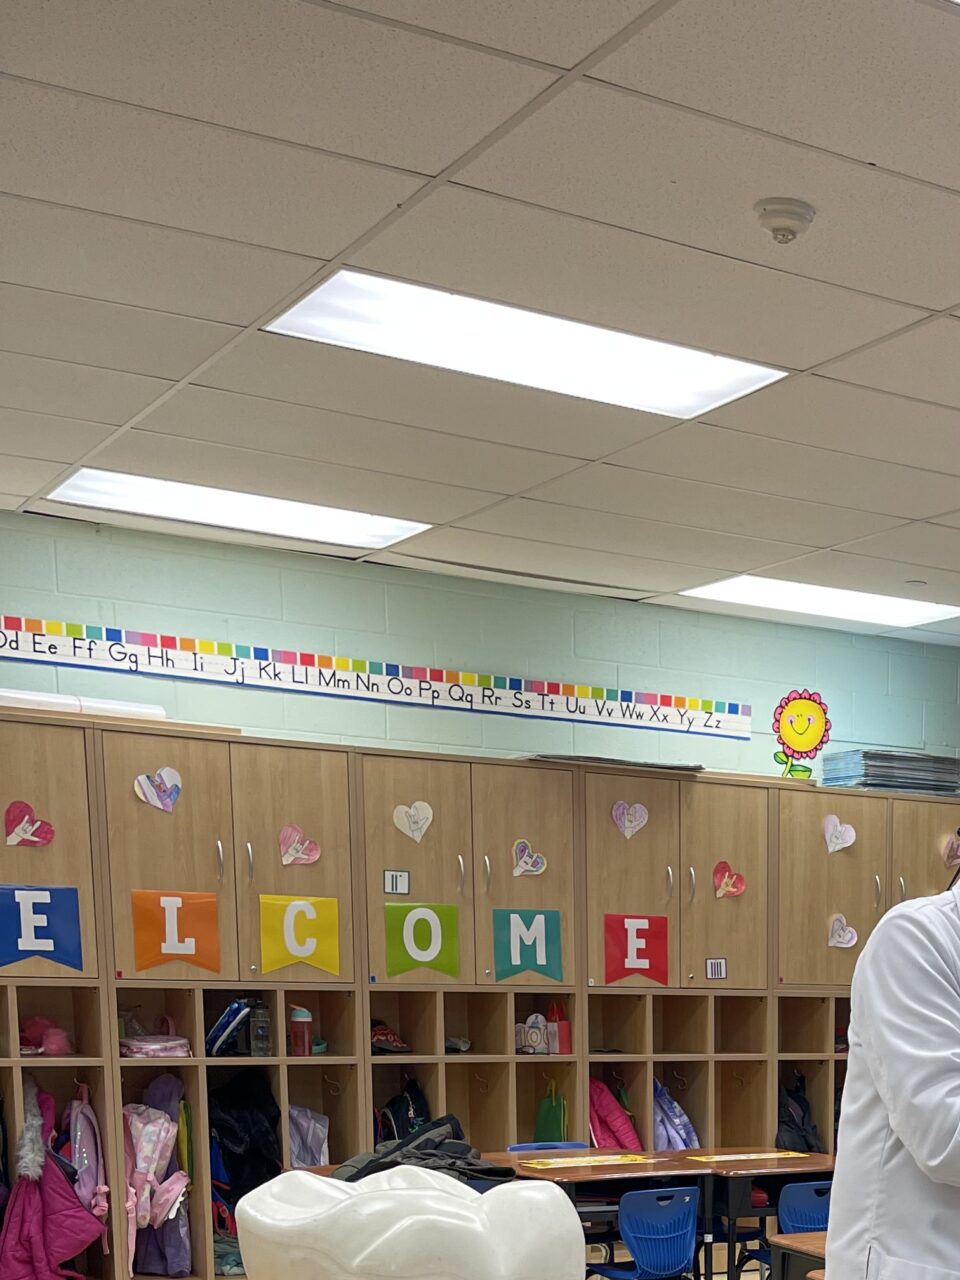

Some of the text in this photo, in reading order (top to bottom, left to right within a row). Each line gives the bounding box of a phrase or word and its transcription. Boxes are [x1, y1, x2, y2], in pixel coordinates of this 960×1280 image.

[33, 633, 58, 654] Ee
[72, 638, 96, 658] Ff
[108, 642, 138, 672] Gg
[147, 647, 174, 668] Hh
[192, 652, 203, 672] Ii
[224, 658, 245, 684] Jj
[259, 662, 282, 680] Kk
[292, 666, 308, 684] Ll
[318, 670, 350, 689] Mm
[357, 673, 379, 692] Nn
[388, 677, 412, 696] Oo
[419, 680, 440, 705] Pp
[448, 684, 473, 709] Qq
[482, 688, 501, 705] Rr
[512, 691, 531, 709] Ss
[537, 694, 555, 711] Tt
[566, 696, 586, 714] Uu
[595, 700, 613, 717] Vv
[620, 703, 644, 720] Ww
[649, 707, 668, 722] Xx
[677, 710, 695, 732] Yy
[703, 712, 721, 728] Zz
